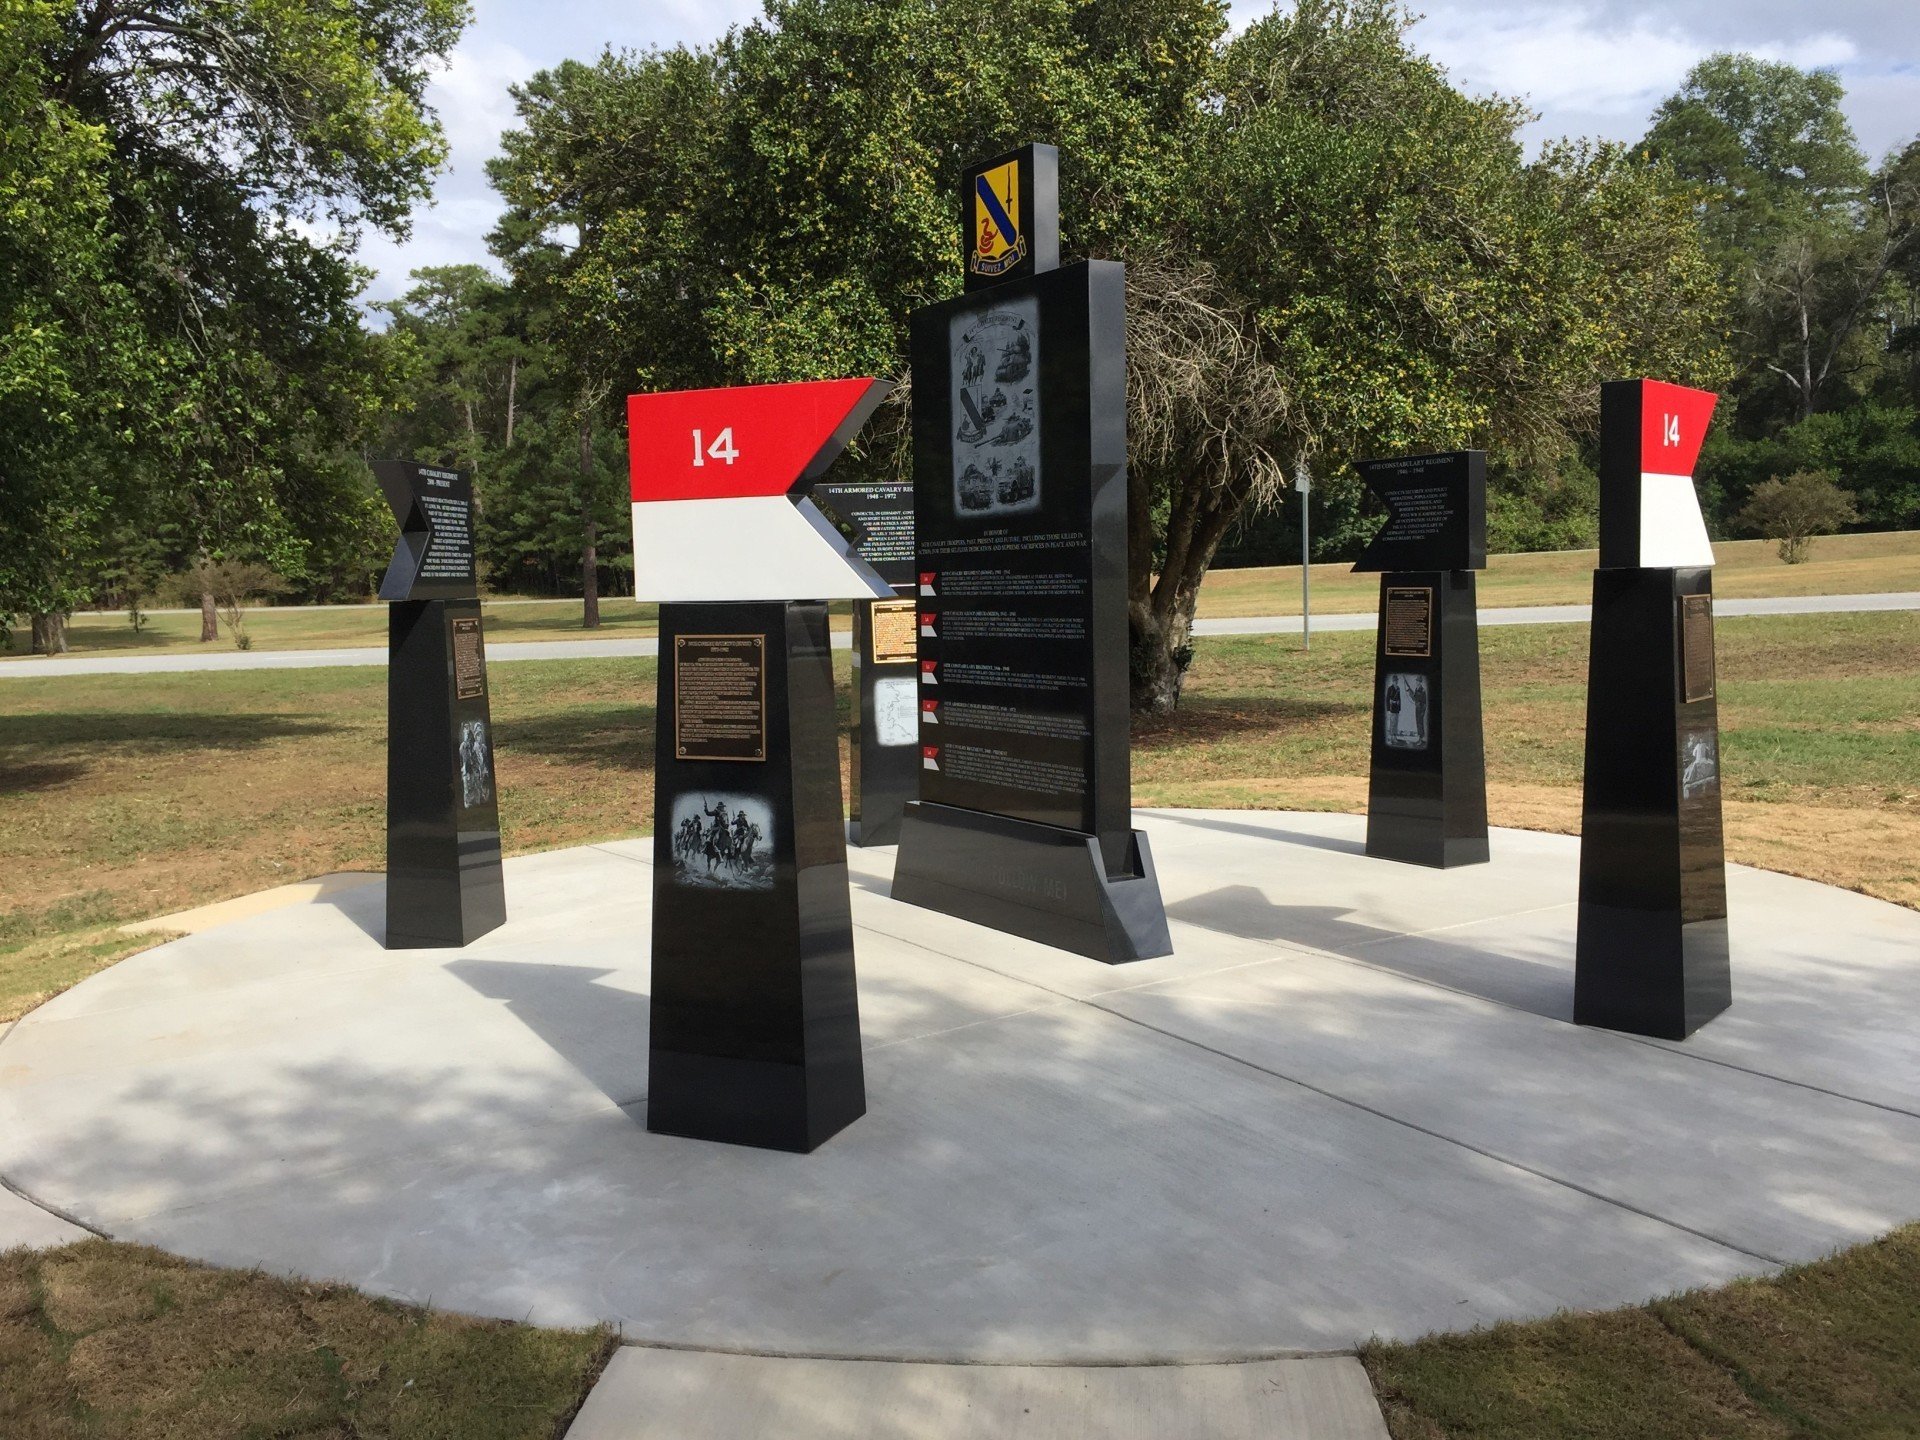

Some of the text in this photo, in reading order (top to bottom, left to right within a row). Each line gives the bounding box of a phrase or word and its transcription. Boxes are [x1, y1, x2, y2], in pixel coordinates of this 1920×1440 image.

[692, 427, 740, 467] 14
[1663, 413, 1680, 447] 14
[1381, 460, 1425, 469] CONSTABULARY
[1425, 456, 1455, 465] REGIMENT
